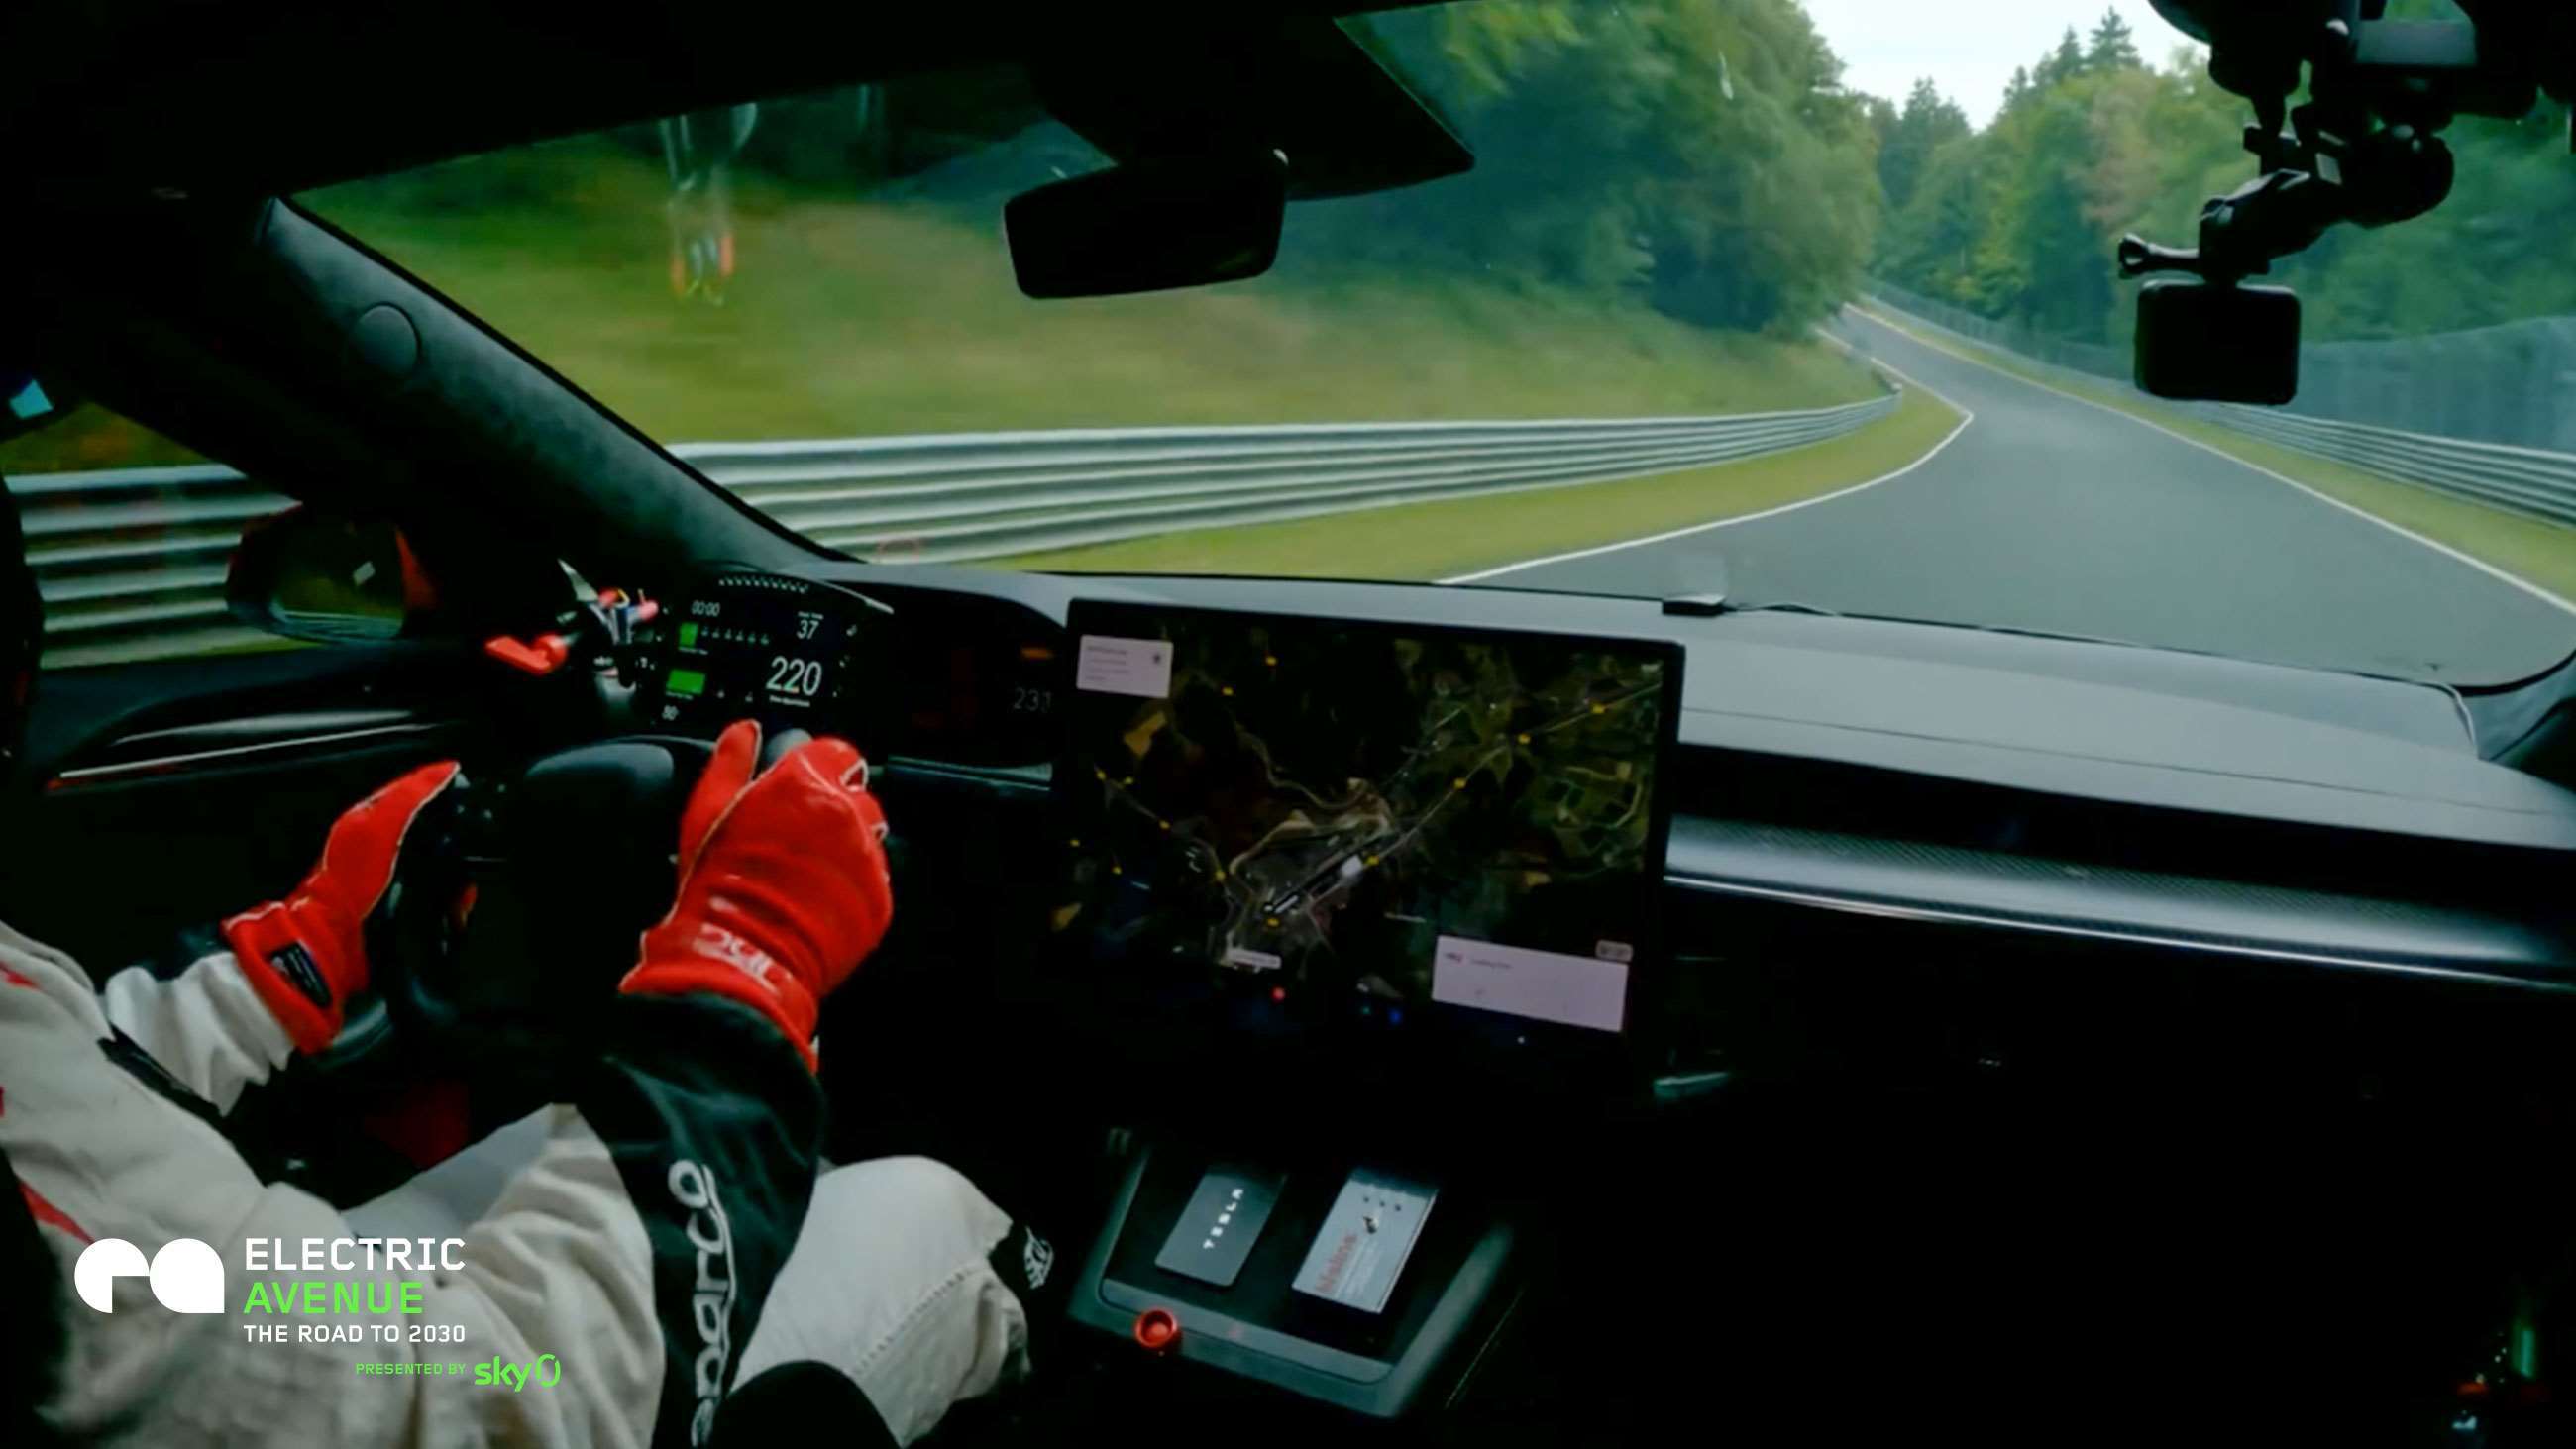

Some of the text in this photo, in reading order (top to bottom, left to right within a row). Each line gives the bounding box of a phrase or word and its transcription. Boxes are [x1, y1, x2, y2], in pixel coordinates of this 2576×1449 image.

[795, 619, 820, 641] 37
[764, 655, 823, 697] 220
[1202, 1188, 1244, 1250] TESLA
